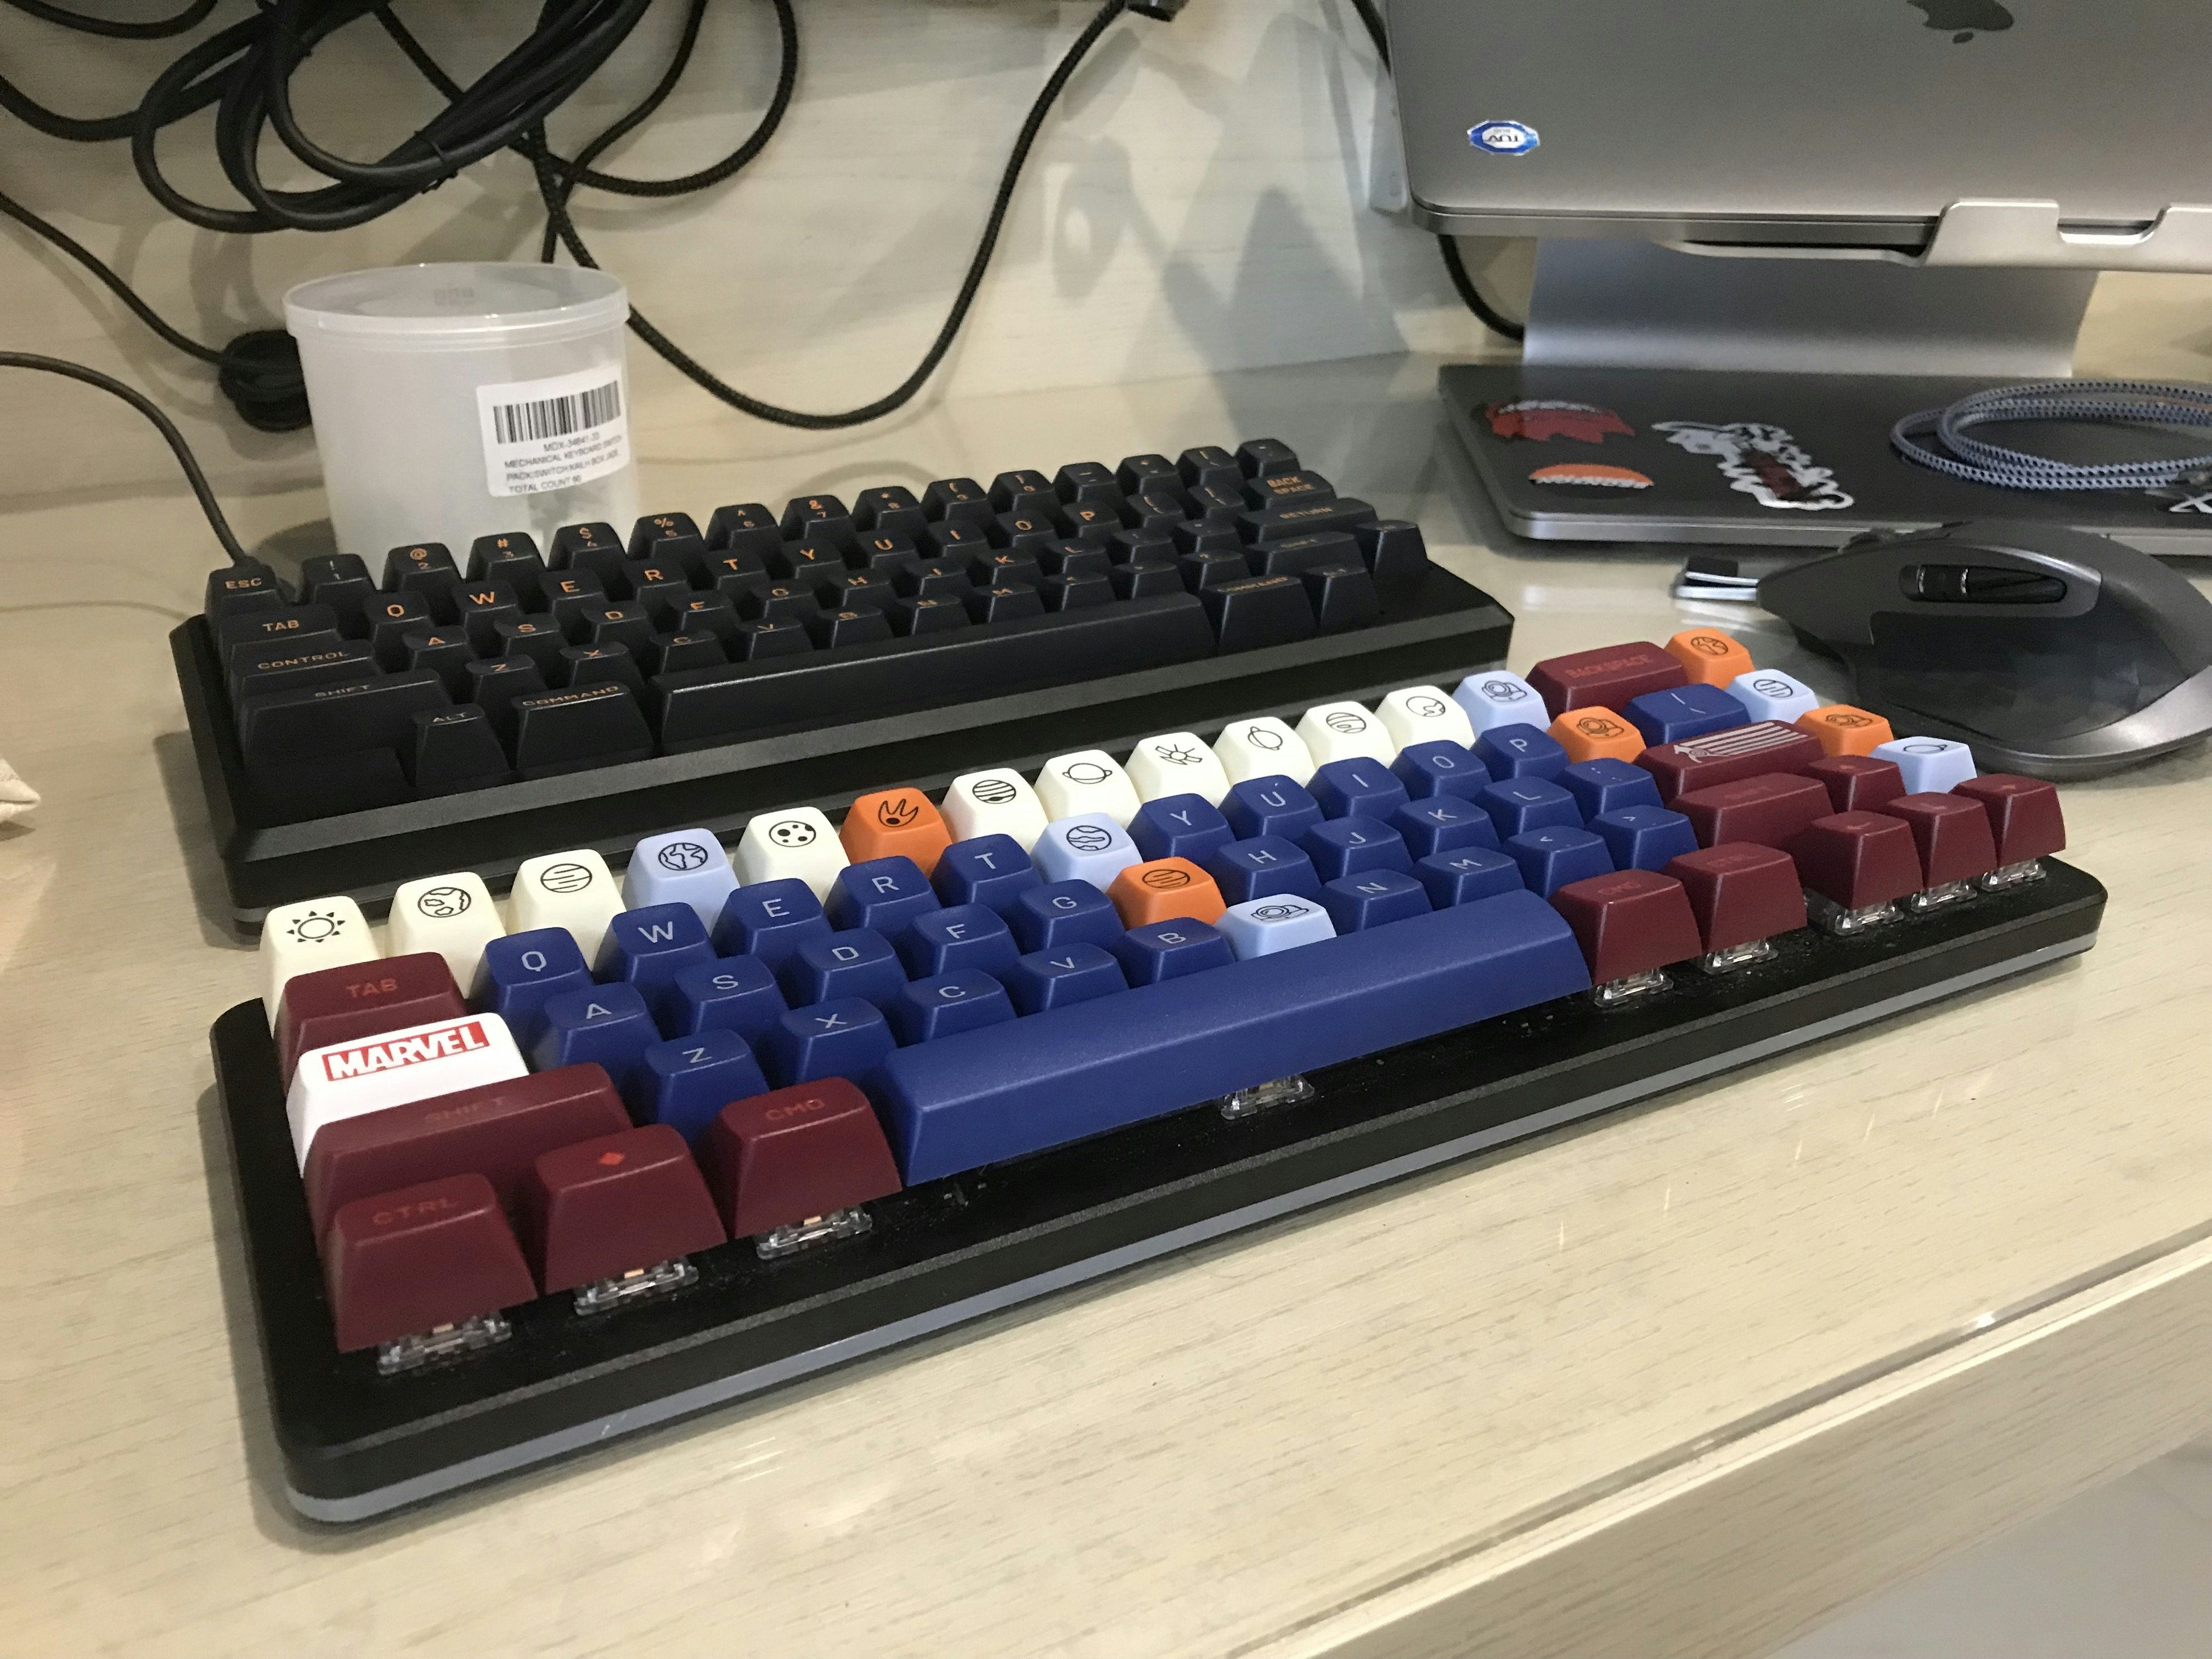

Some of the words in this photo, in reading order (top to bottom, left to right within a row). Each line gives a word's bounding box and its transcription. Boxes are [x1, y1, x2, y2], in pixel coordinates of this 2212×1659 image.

[509, 483, 538, 493] TOTAL
[875, 539, 893, 550] U
[410, 548, 427, 560] @
[800, 549, 814, 560] Y
[724, 559, 737, 569] T
[645, 570, 663, 580] R
[225, 578, 261, 589] ESC
[561, 581, 579, 592] E
[470, 592, 494, 604] W
[263, 620, 299, 631] TAB
[428, 637, 445, 645] A
[258, 651, 349, 669] CONTROL
[315, 685, 369, 697] SHIFT
[522, 686, 619, 706] COMMAND
[1509, 739, 1527, 752] P
[1432, 756, 1454, 768] O
[1261, 792, 1285, 806] U
[1513, 792, 1541, 800] L
[1170, 810, 1192, 825] Y
[1428, 809, 1457, 821] K
[1349, 832, 1366, 844] J
[974, 853, 995, 869] T
[1248, 850, 1277, 864] H
[1449, 859, 1482, 869] M
[872, 877, 899, 893] R
[1357, 883, 1387, 893] N
[762, 899, 789, 917] E
[1053, 897, 1076, 909] G
[638, 921, 673, 943] W
[946, 924, 965, 938] F
[1158, 933, 1186, 944] B
[832, 947, 859, 961] D
[522, 951, 546, 972] Q
[1050, 957, 1074, 968] V
[347, 978, 398, 998] TAB
[713, 975, 738, 989] S
[939, 986, 966, 997] C
[586, 1003, 612, 1019] A
[815, 1014, 847, 1028] X
[324, 1022, 490, 1081] MARVEL
[682, 1048, 712, 1063] Z
[767, 1098, 825, 1121] CMD
[373, 1197, 456, 1226] CTRL
